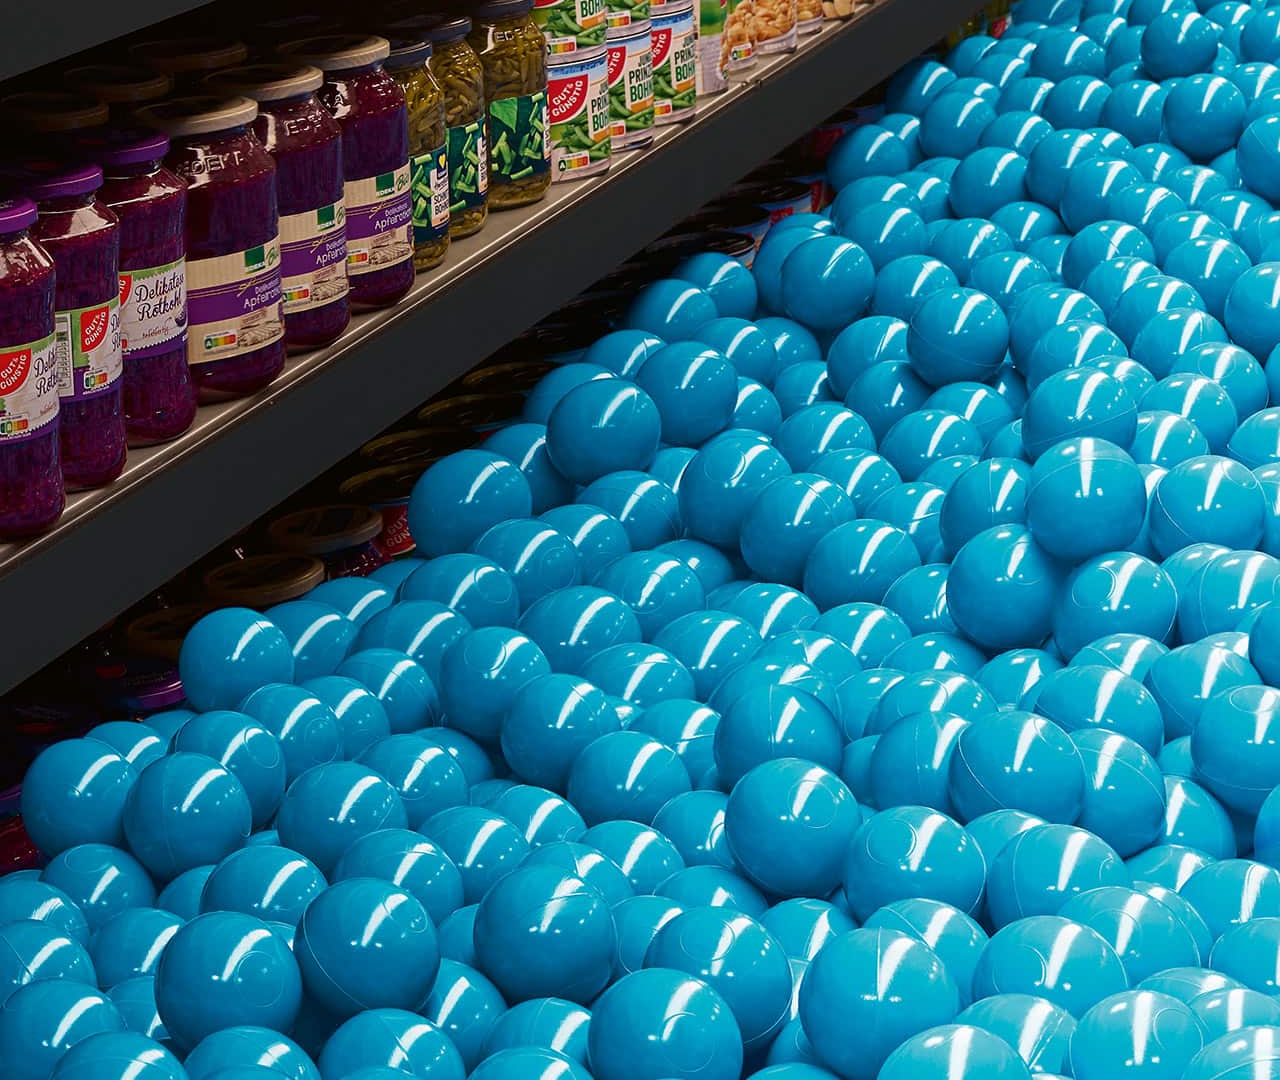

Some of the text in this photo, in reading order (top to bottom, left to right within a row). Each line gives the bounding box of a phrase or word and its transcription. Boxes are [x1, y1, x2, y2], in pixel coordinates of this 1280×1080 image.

[552, 80, 584, 117] GÜNSTIG
[553, 83, 574, 105] GUT&
[137, 290, 182, 321] Rotkohl
